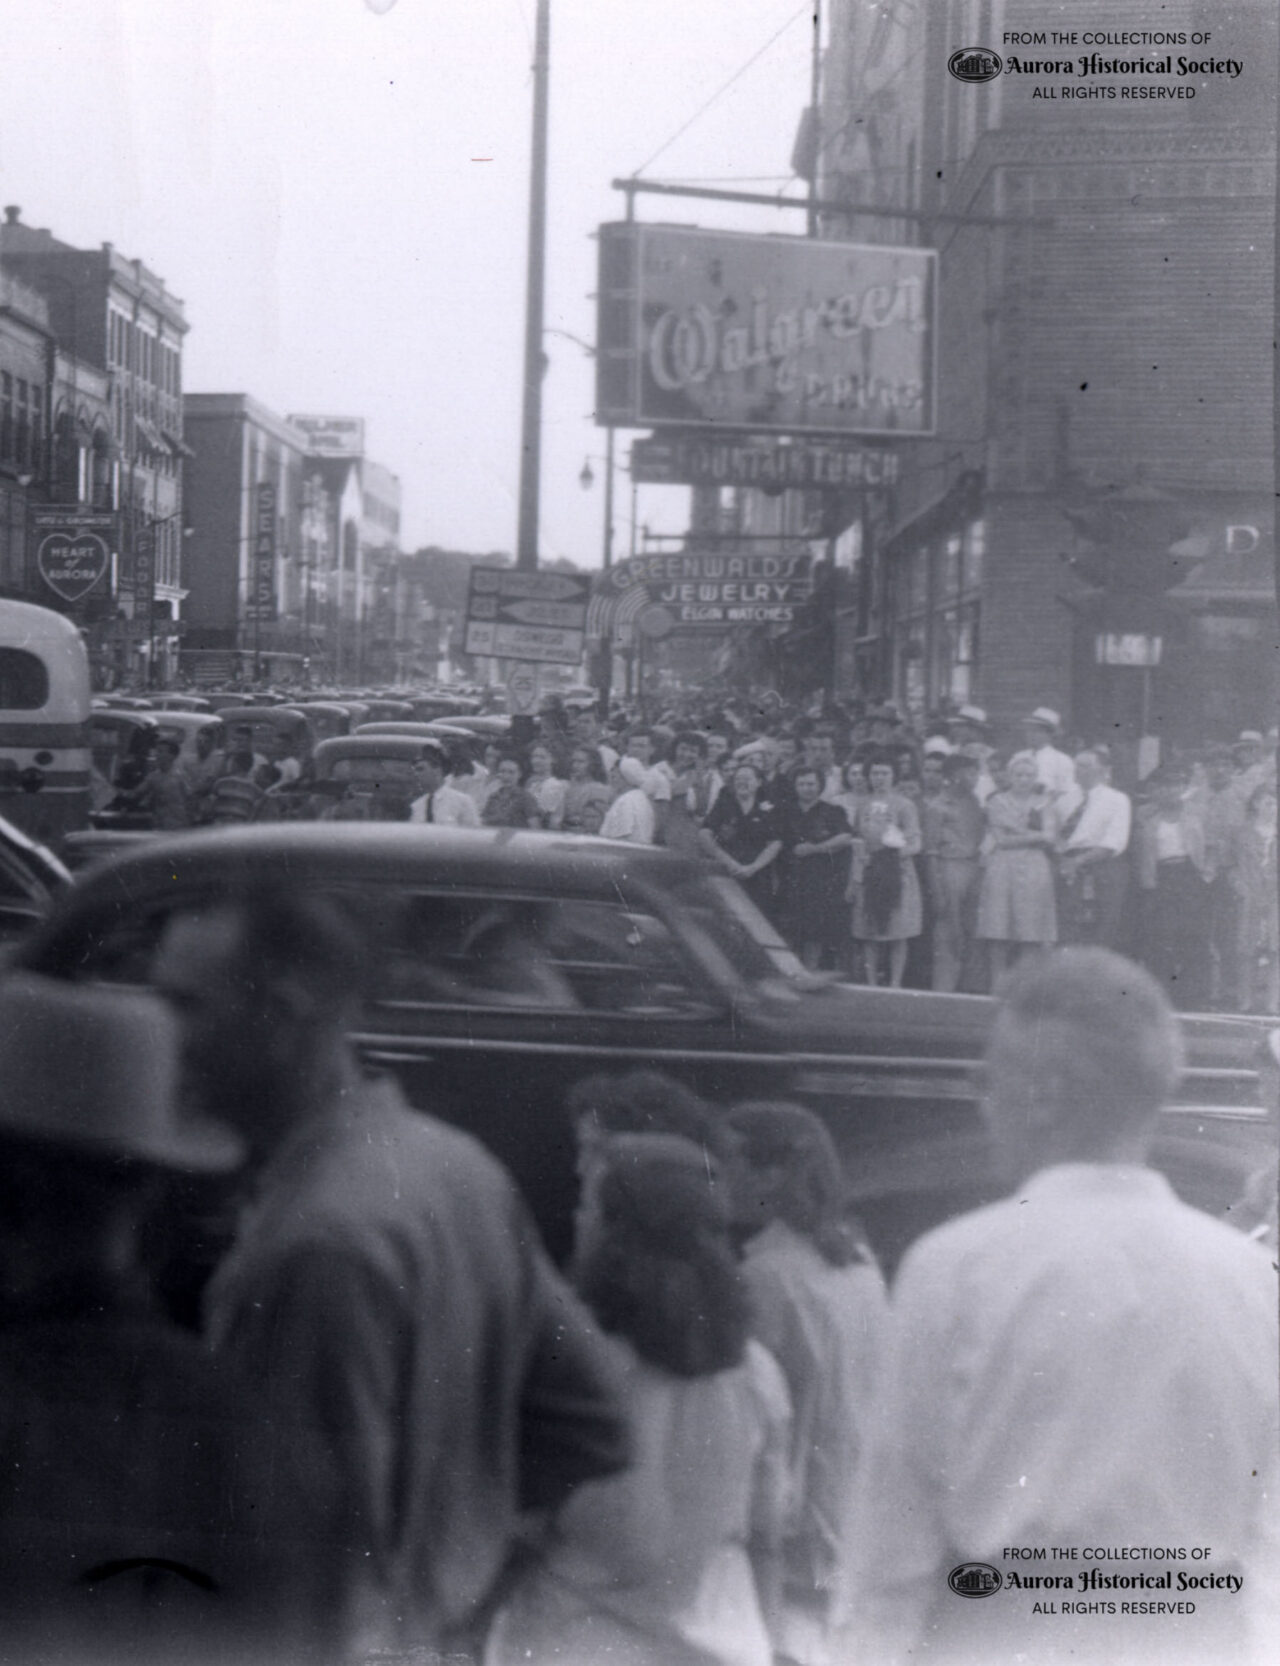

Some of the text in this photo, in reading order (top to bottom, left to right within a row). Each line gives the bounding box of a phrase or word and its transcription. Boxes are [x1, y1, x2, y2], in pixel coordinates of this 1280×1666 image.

[50, 547, 96, 557] HEART
[258, 490, 274, 602] SEARS
[64, 558, 80, 570] of
[48, 569, 97, 580] AURORA
[662, 584, 790, 602] JEWELRY
[681, 605, 794, 621] ELGIN WATCHES
